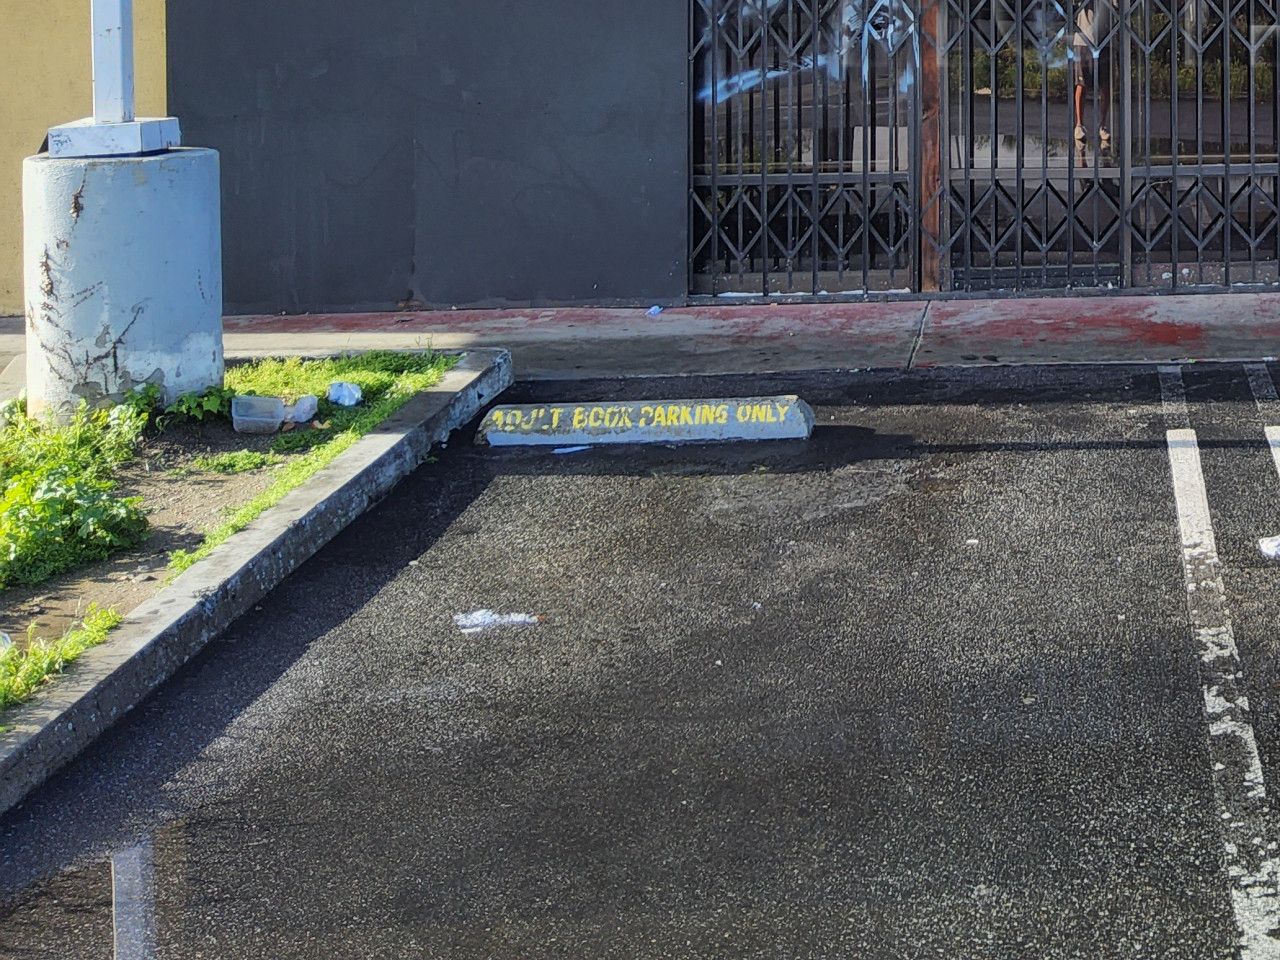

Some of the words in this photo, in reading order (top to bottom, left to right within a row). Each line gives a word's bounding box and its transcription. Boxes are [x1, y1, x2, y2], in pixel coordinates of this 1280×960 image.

[572, 406, 634, 429] BOOK
[639, 404, 729, 427] PARKING
[736, 402, 789, 423] ONLY
